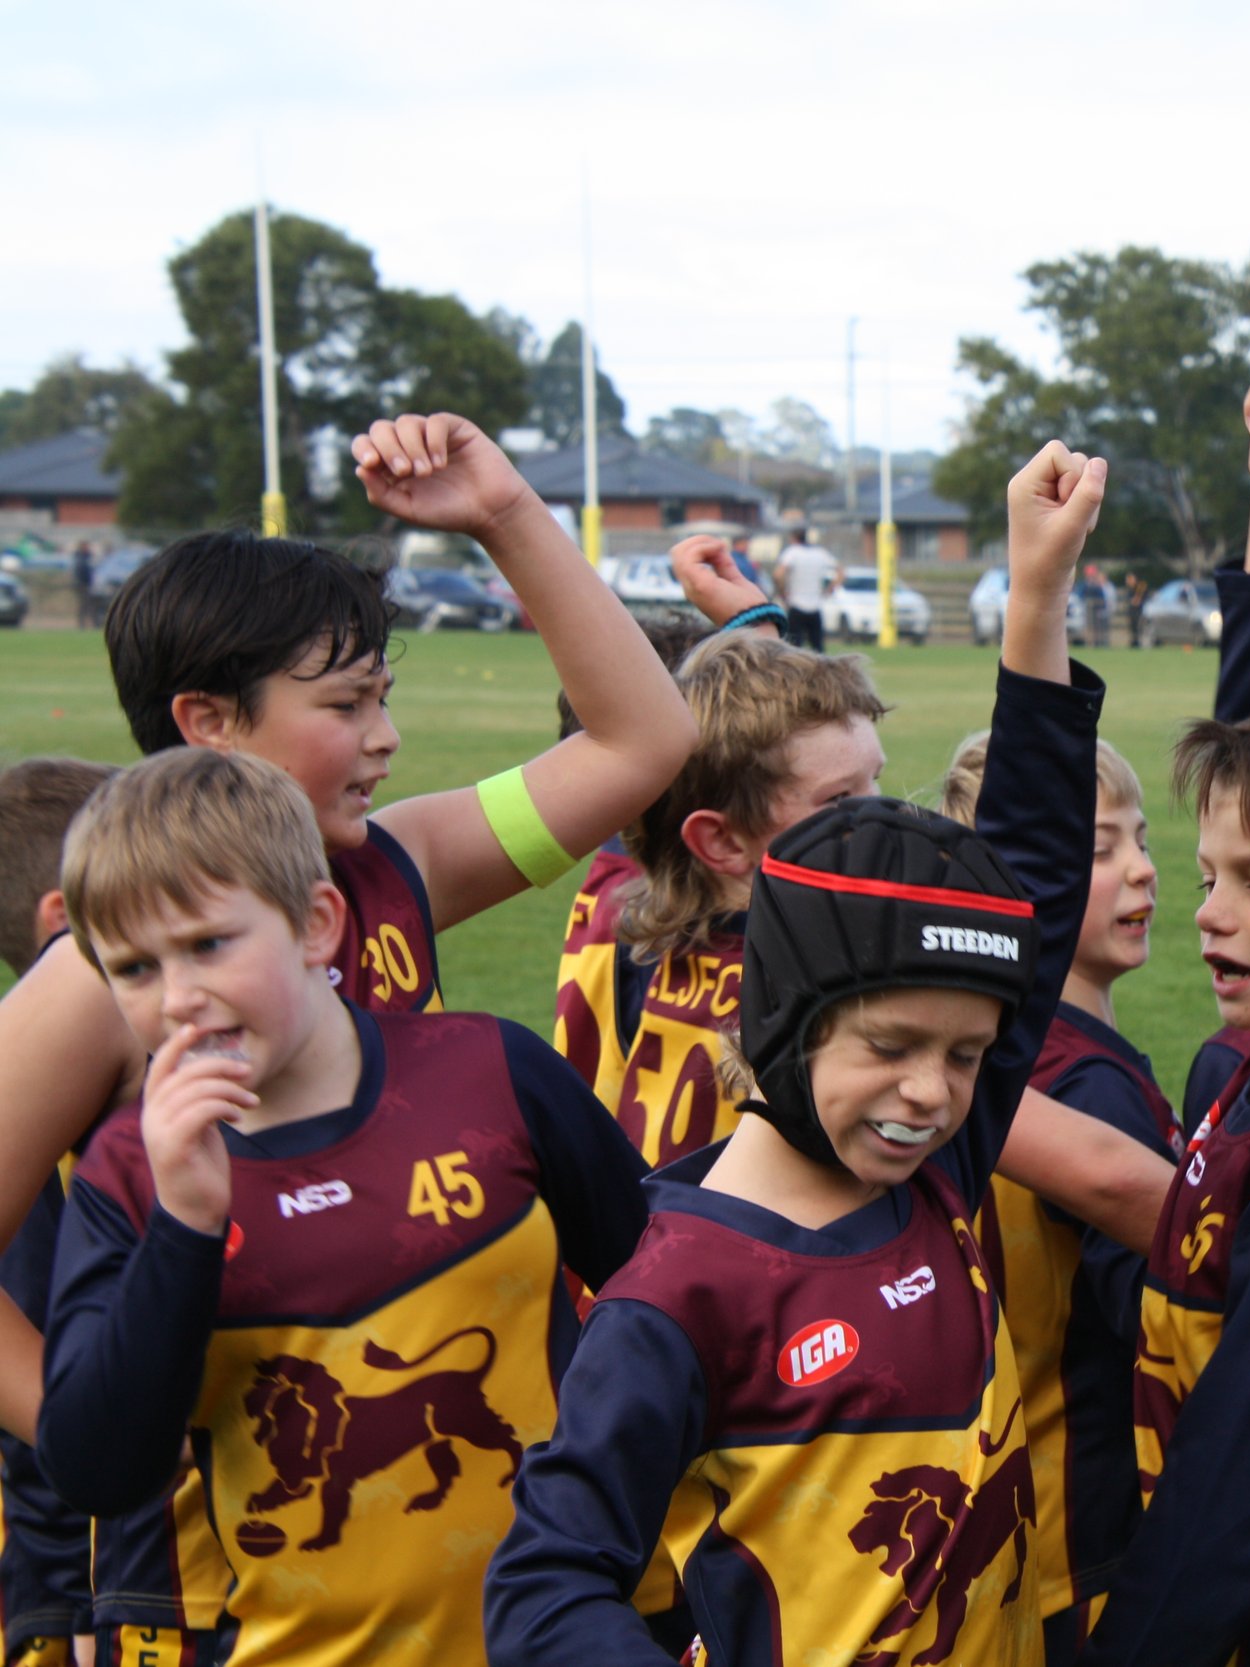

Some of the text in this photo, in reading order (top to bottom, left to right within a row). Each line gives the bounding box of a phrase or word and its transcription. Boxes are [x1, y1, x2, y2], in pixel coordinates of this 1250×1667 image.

[361, 923, 419, 1004] 30
[921, 924, 1019, 962] STEEDEN
[648, 952, 743, 1017] LJFC
[407, 1150, 485, 1226] 45
[790, 1323, 847, 1383] IGA
